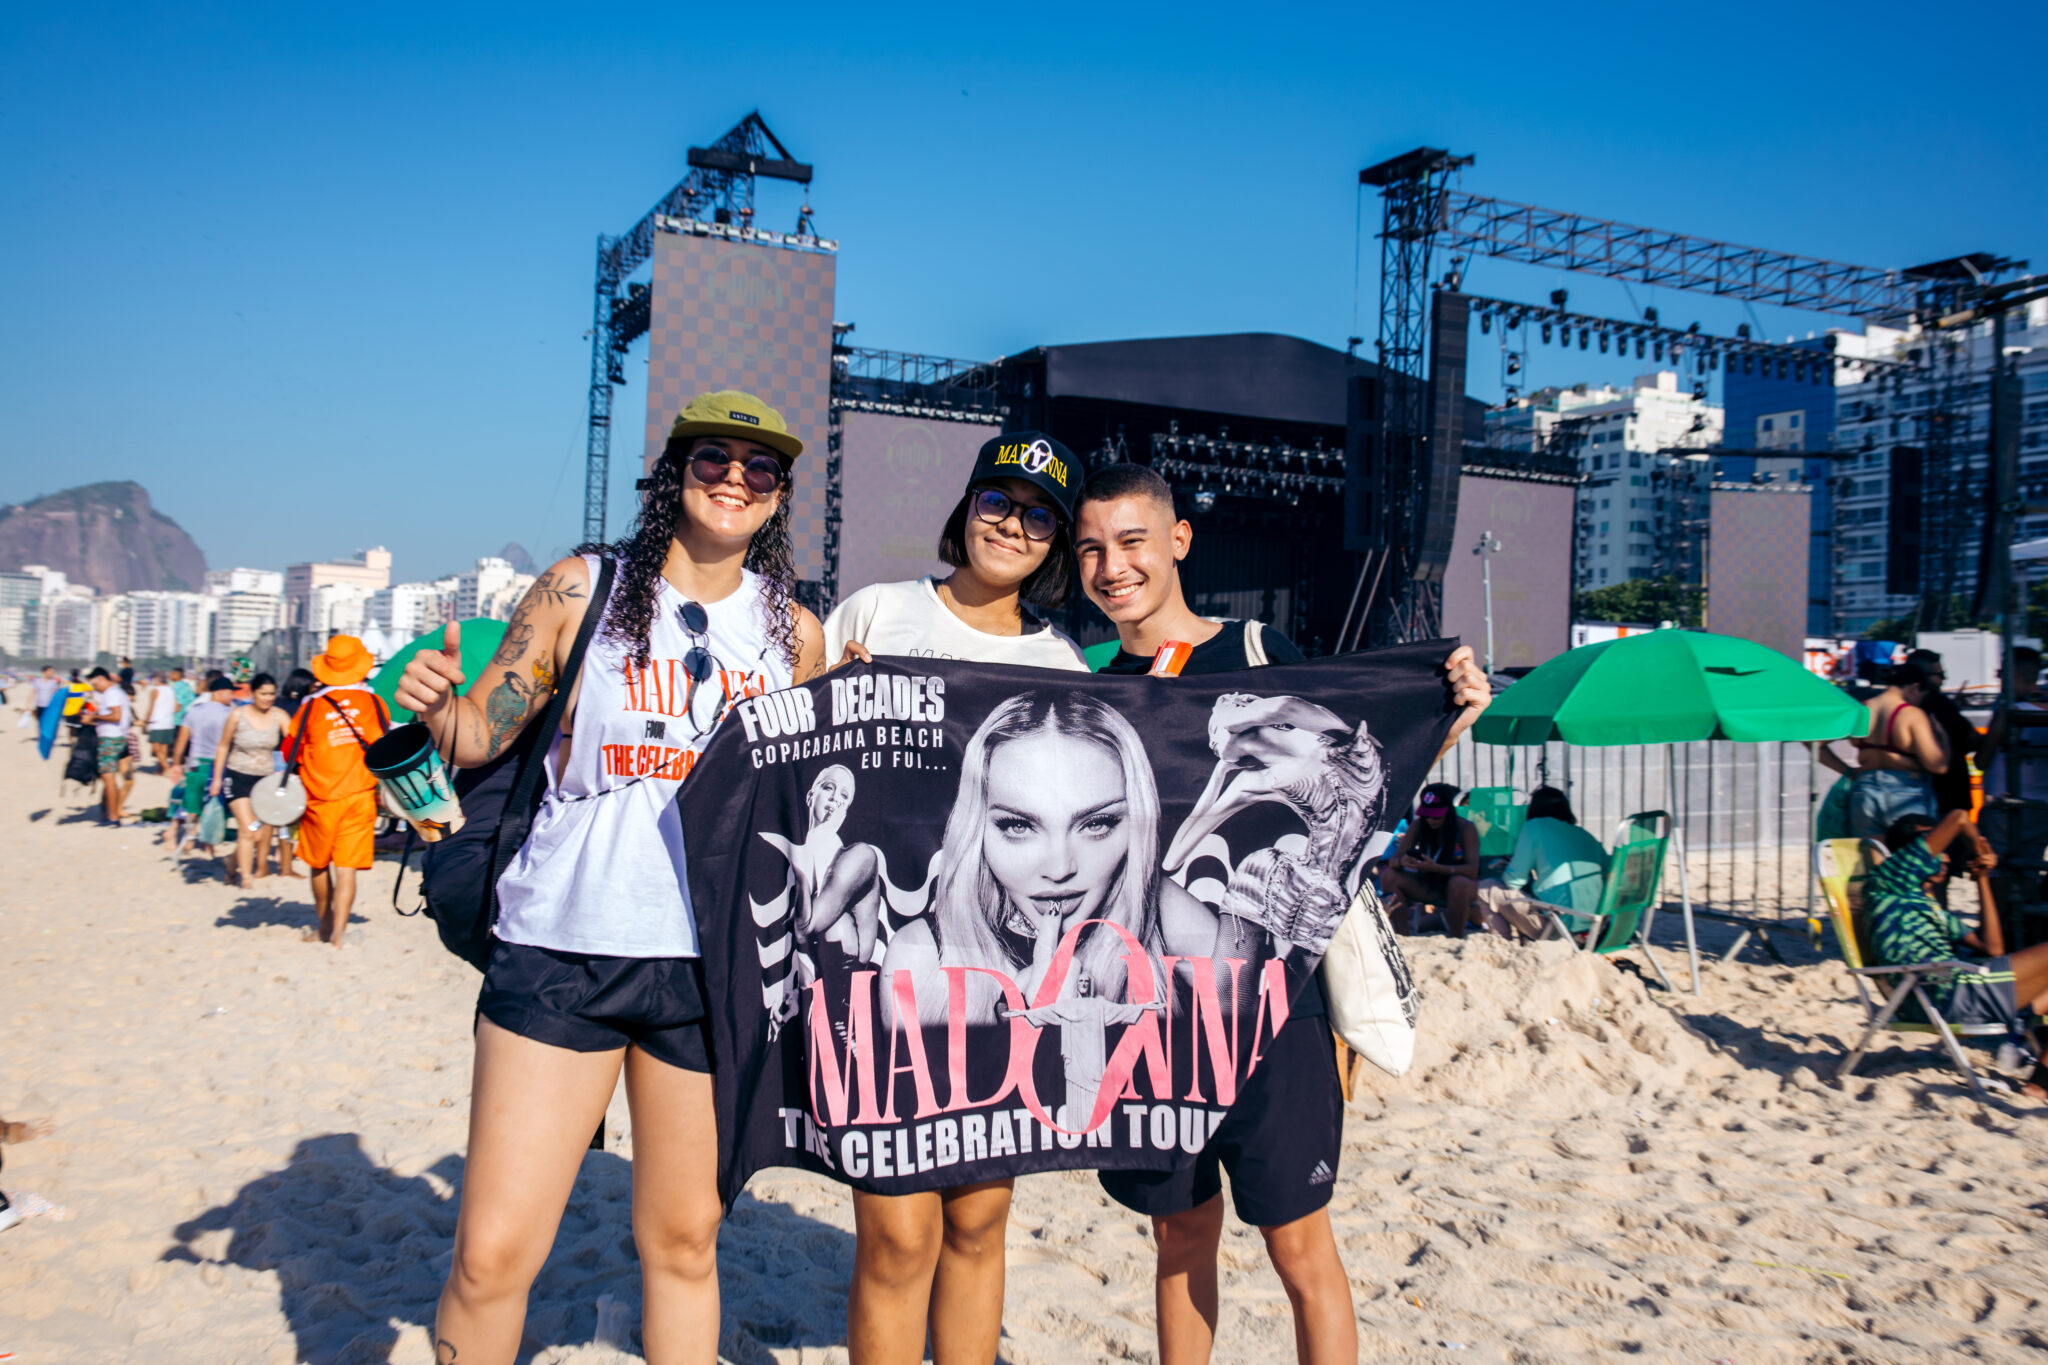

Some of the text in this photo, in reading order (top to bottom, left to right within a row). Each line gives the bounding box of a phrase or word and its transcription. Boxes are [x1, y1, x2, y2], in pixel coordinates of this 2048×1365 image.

[995, 440, 1067, 487] MADONNA
[737, 674, 945, 742] FOUR DECADES
[602, 744, 703, 781] THE CELEBR
[752, 726, 943, 769] COPACABANA BEACH
[861, 752, 881, 770] EU
[841, 1104, 1112, 1179] CELEBRATION
